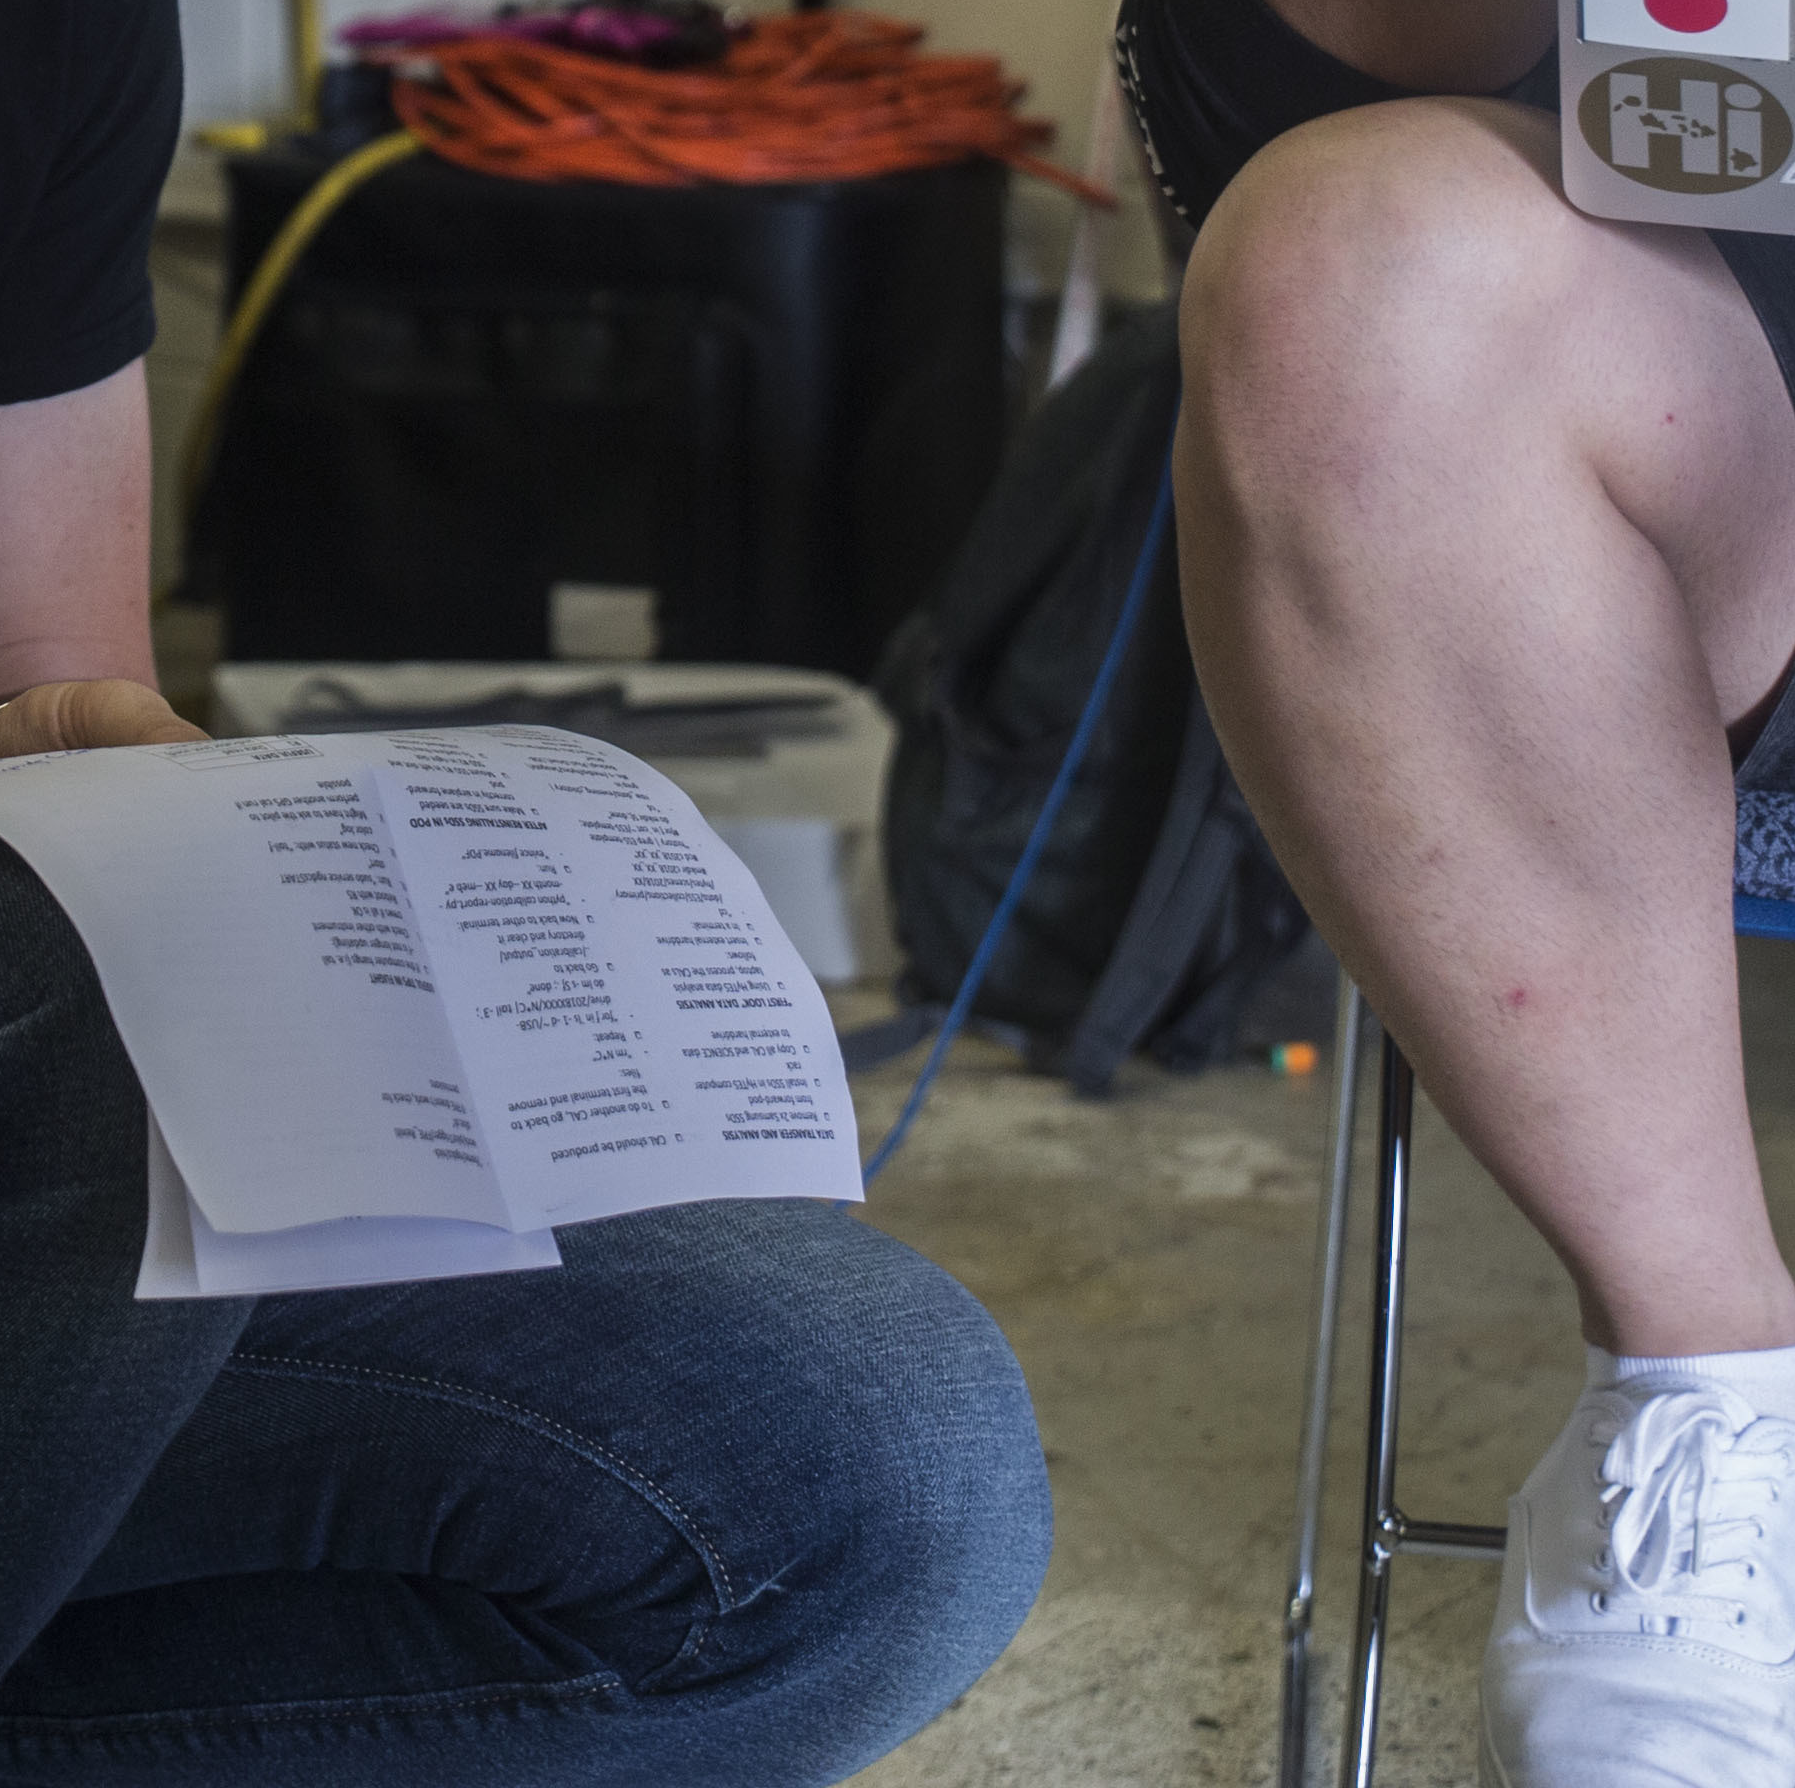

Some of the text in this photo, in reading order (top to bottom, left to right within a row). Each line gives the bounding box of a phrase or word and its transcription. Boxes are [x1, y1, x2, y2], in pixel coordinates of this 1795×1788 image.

[1609, 71, 1764, 179] Hi
[408, 817, 431, 827] POD
[431, 817, 443, 826] IN
[443, 817, 465, 826] SSDs
[465, 817, 523, 828] REINSTALLING
[445, 895, 536, 910] calibration-report.py
[455, 915, 579, 932] Now back to other terminal:
[496, 929, 585, 944] directory and clear it
[553, 962, 599, 973] Go back to
[661, 967, 671, 975] as
[691, 966, 705, 975] the
[705, 965, 734, 974] process
[673, 981, 703, 992] analysis
[705, 982, 722, 991] data
[675, 999, 739, 1009] DATA ANALYSIS
[748, 1029, 779, 1039] external
[682, 1047, 700, 1057] data
[701, 1047, 734, 1056] SCIENCE
[734, 1046, 749, 1056] and
[750, 1046, 765, 1054] CAL
[776, 1044, 796, 1054] Copy
[695, 1079, 731, 1089] computer
[507, 1084, 647, 1112] the first terminal and remove
[589, 1103, 626, 1116] another
[627, 1102, 640, 1113] do
[641, 1100, 654, 1111] To
[524, 1115, 548, 1129] back
[550, 1111, 563, 1123] go
[510, 1121, 523, 1130] to
[723, 1129, 834, 1140] DATA TRANSFER AND ANALYSIS
[550, 1134, 666, 1162] CAL should be produced
